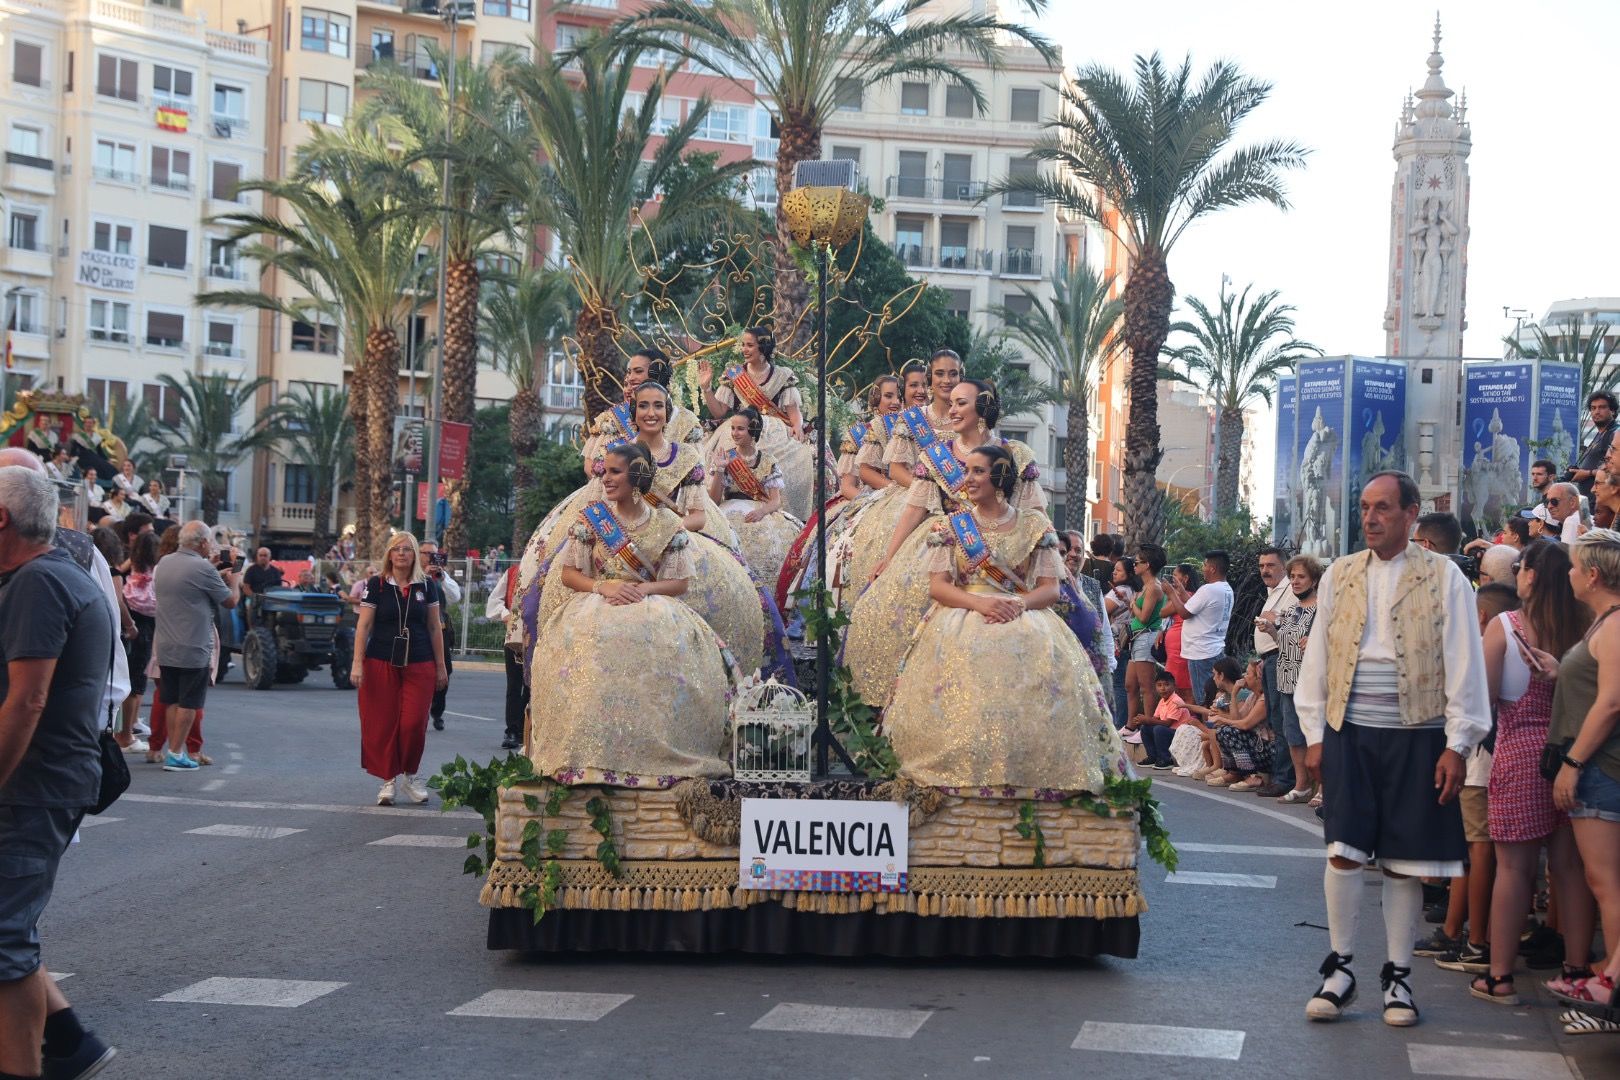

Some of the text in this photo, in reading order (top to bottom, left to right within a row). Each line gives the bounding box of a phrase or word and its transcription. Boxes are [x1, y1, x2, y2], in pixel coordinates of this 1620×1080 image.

[80, 265, 100, 283] NO
[1304, 380, 1327, 388] ESTAMOS
[1504, 382, 1517, 390] AQUÍ
[754, 820, 895, 857] VALENCIA
